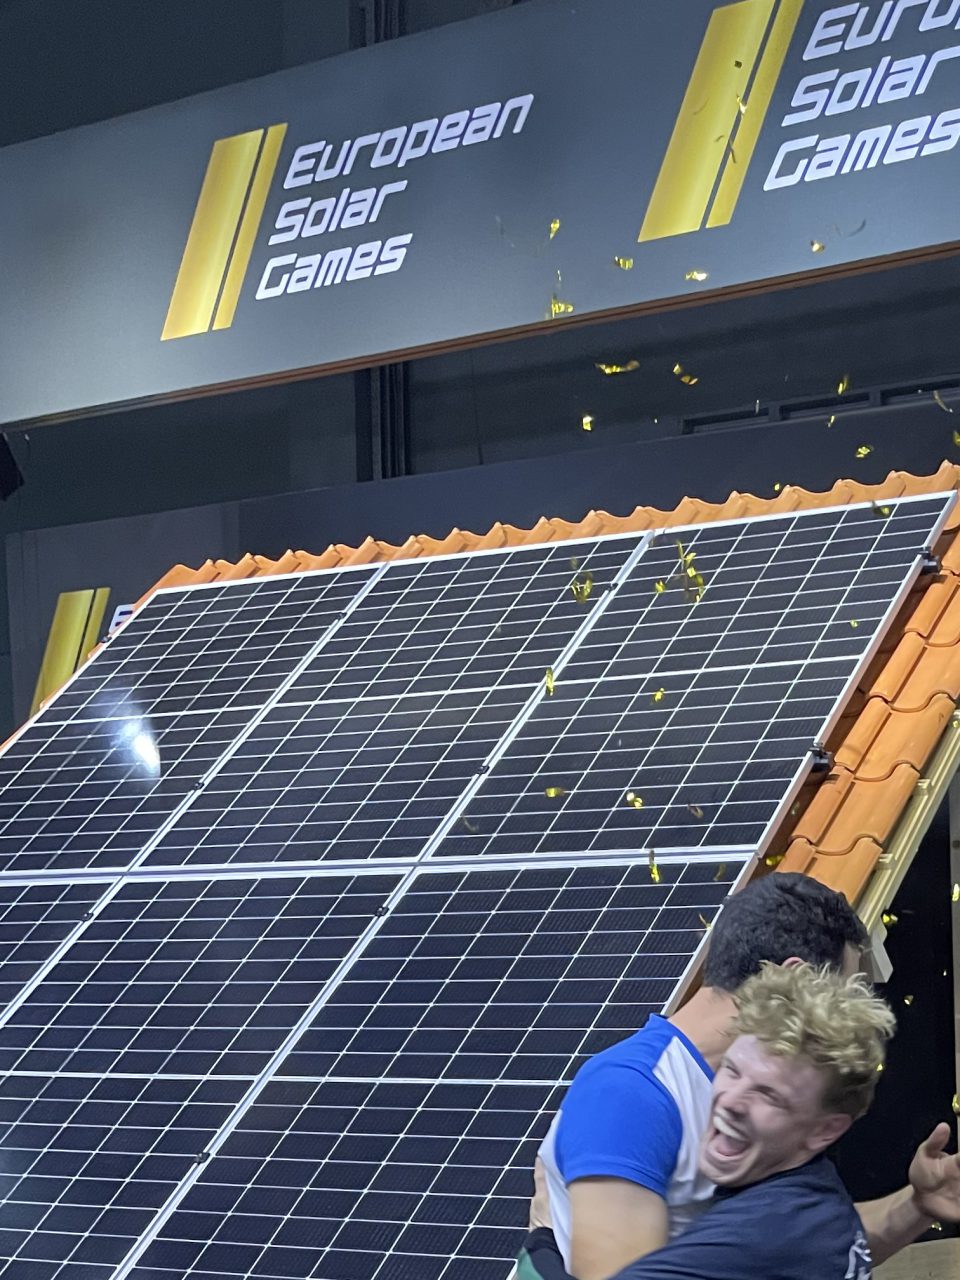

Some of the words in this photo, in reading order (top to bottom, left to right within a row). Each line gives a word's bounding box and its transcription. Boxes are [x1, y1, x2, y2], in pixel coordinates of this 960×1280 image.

[283, 94, 534, 189] European
[268, 180, 408, 245] Solar
[255, 233, 413, 300] Games
